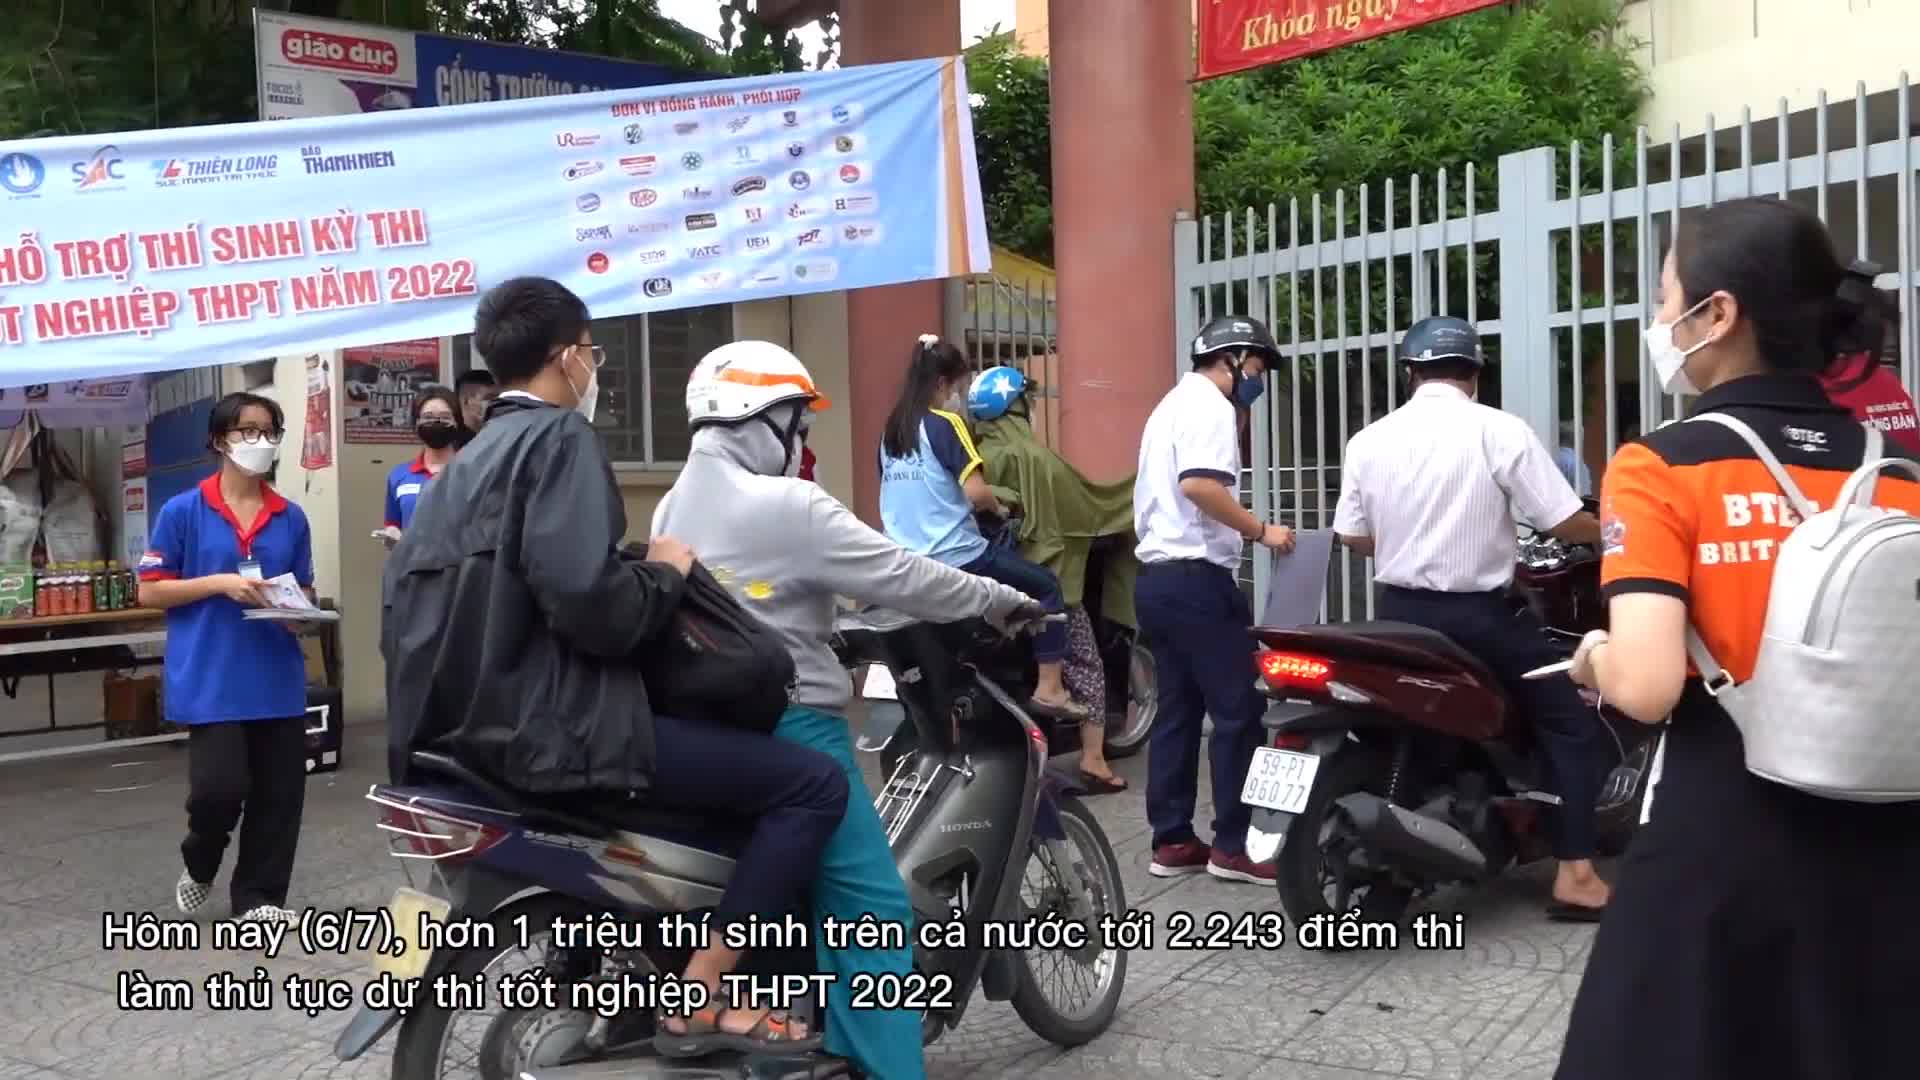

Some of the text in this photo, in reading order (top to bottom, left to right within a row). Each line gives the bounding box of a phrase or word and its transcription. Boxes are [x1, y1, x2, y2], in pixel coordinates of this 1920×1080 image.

[1241, 8, 1317, 51] Khóa
[286, 33, 394, 70] giáo dục
[236, 155, 278, 172] LONG
[54, 233, 129, 280] TRỢ
[138, 223, 201, 269] THÍ
[211, 221, 301, 262] SINH
[310, 208, 355, 252] KỲ
[367, 209, 424, 246] THI
[33, 286, 177, 338] NGHIỆP
[187, 280, 278, 322] THPT
[290, 266, 377, 311] NĂM
[387, 260, 474, 300] 2022
[1786, 427, 1828, 444] BTEC
[1699, 538, 1780, 565] BRIT
[1247, 777, 1305, 808] 96077
[940, 820, 993, 833] HONDA
